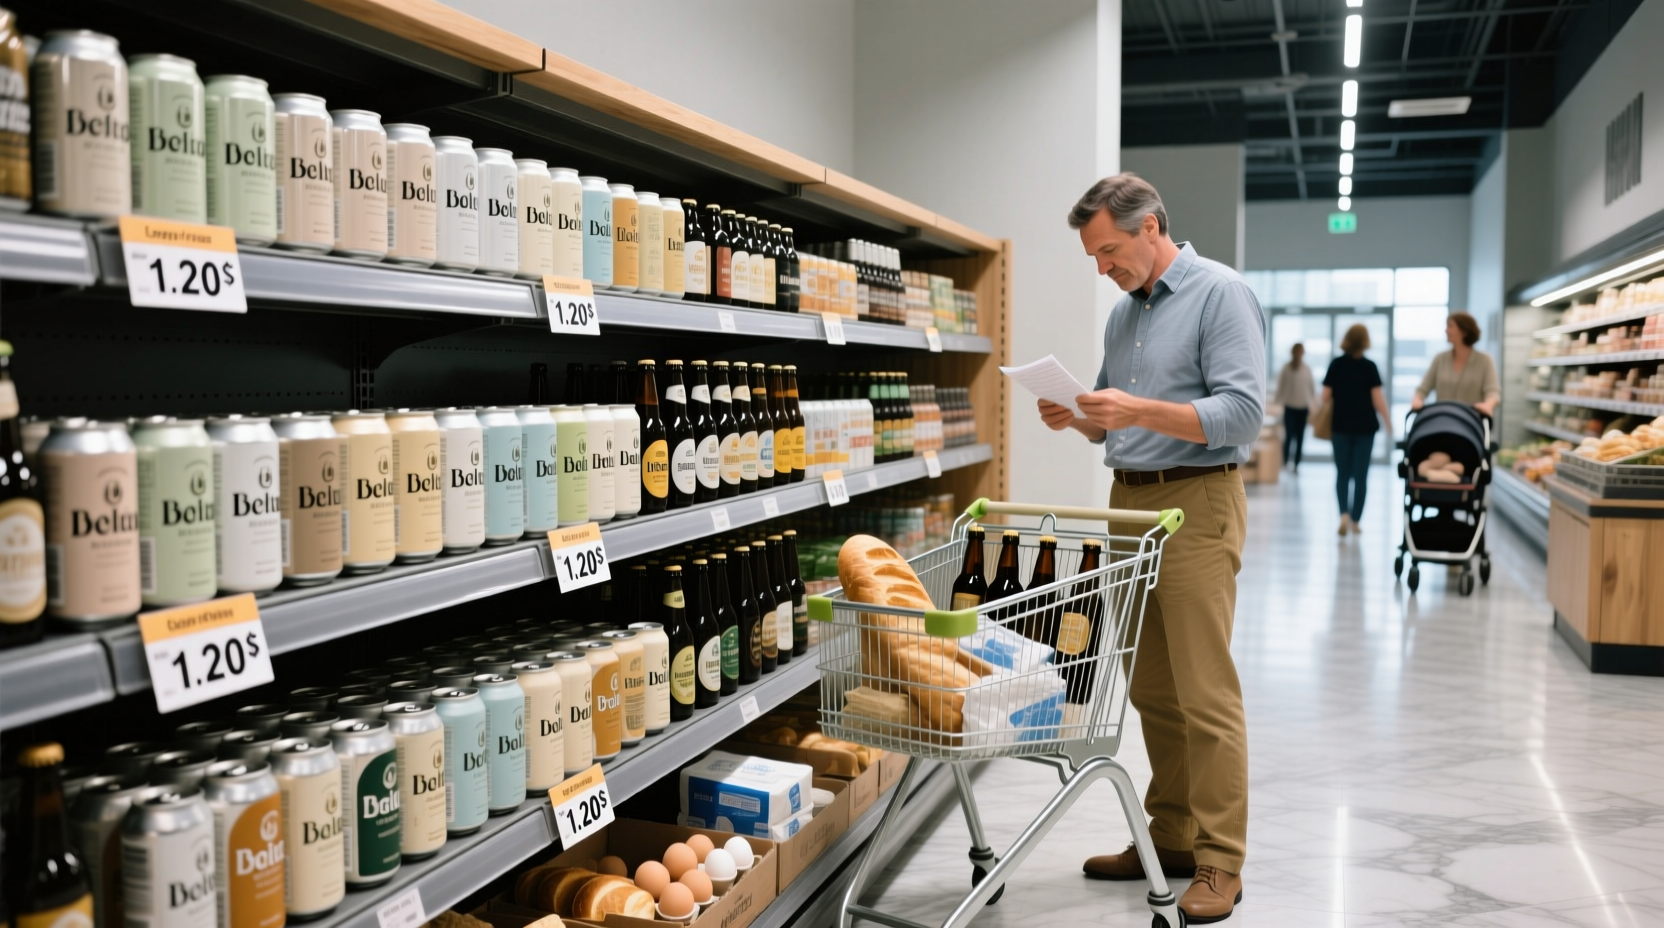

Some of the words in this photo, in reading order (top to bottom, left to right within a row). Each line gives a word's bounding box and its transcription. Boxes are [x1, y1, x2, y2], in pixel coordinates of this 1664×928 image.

[150, 258, 235, 297] 1.20$
[555, 301, 594, 326] 1.20$
[564, 546, 604, 580] 1.20$
[172, 631, 259, 689] 1.20$
[567, 790, 607, 834] 1.20$
